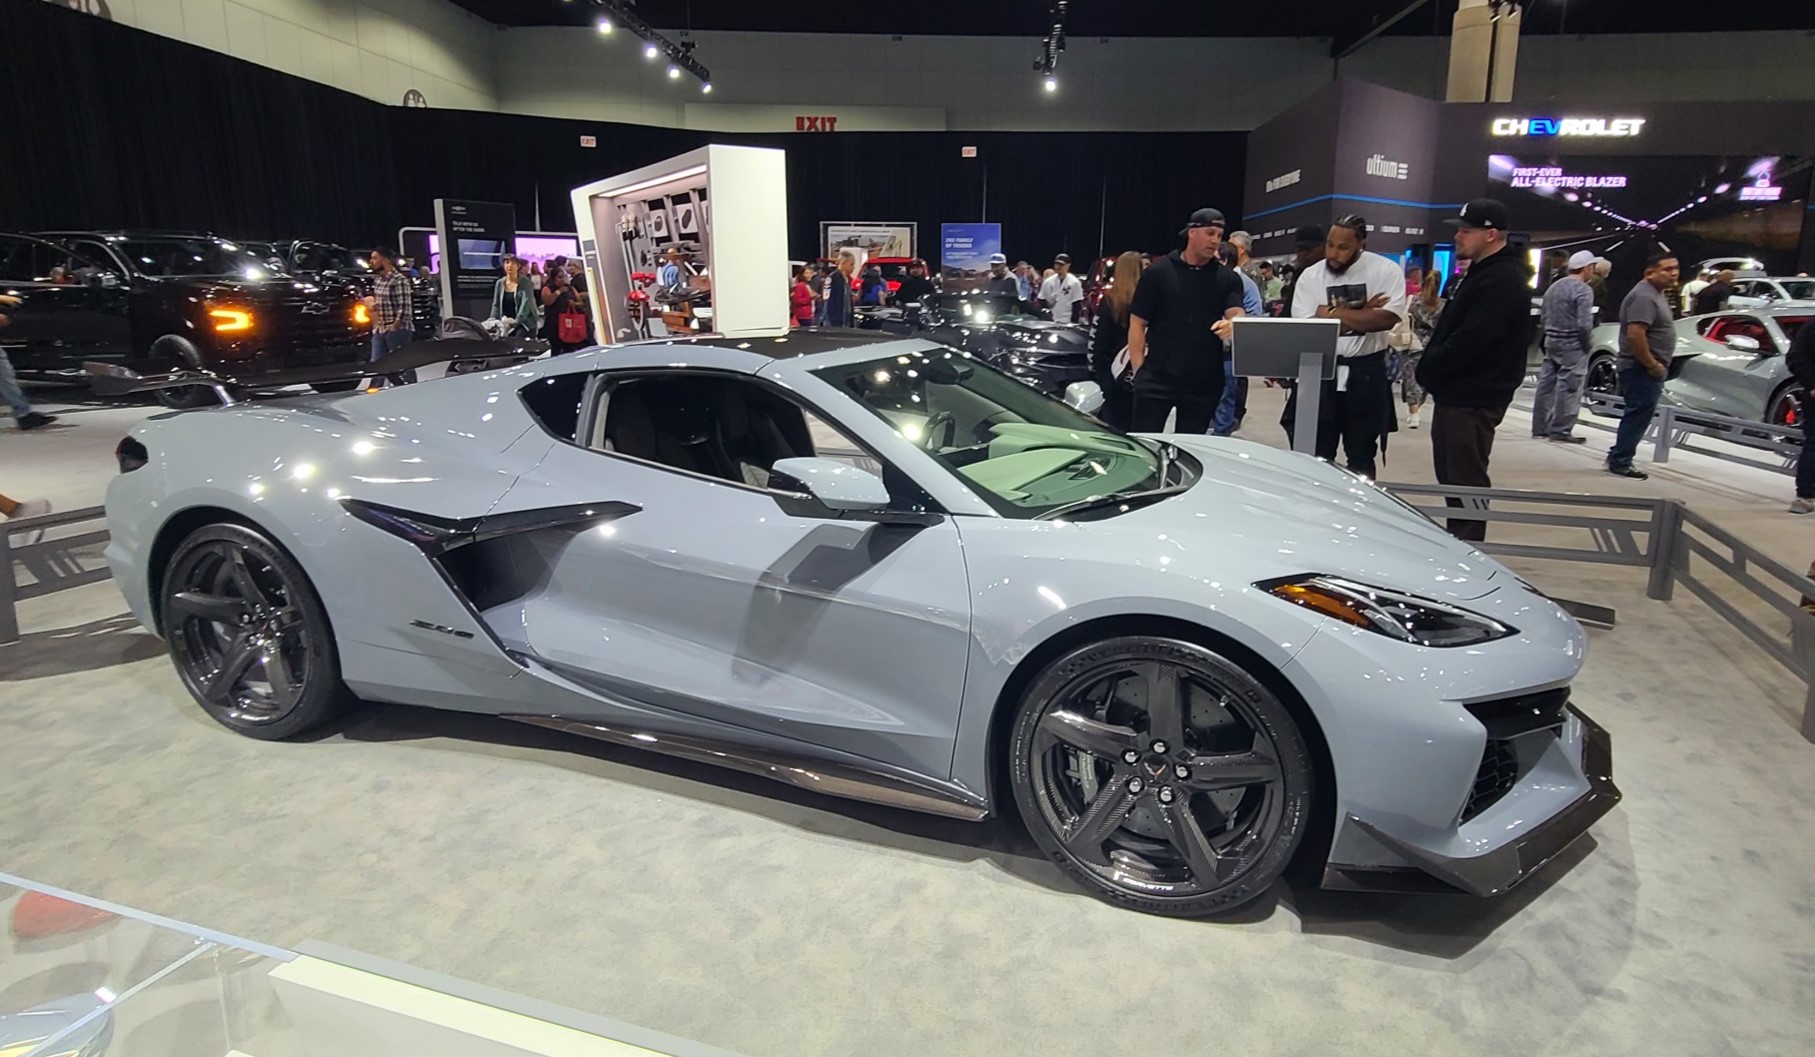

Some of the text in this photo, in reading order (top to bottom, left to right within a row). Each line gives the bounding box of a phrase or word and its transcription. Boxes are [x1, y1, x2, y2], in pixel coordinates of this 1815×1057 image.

[796, 116, 837, 132] EXIT
[1492, 118, 1646, 135] CHEVROLET
[1512, 167, 1562, 177] FIRST-EVER
[1511, 176, 1627, 188] ALL-ELECTRIC BLAZER
